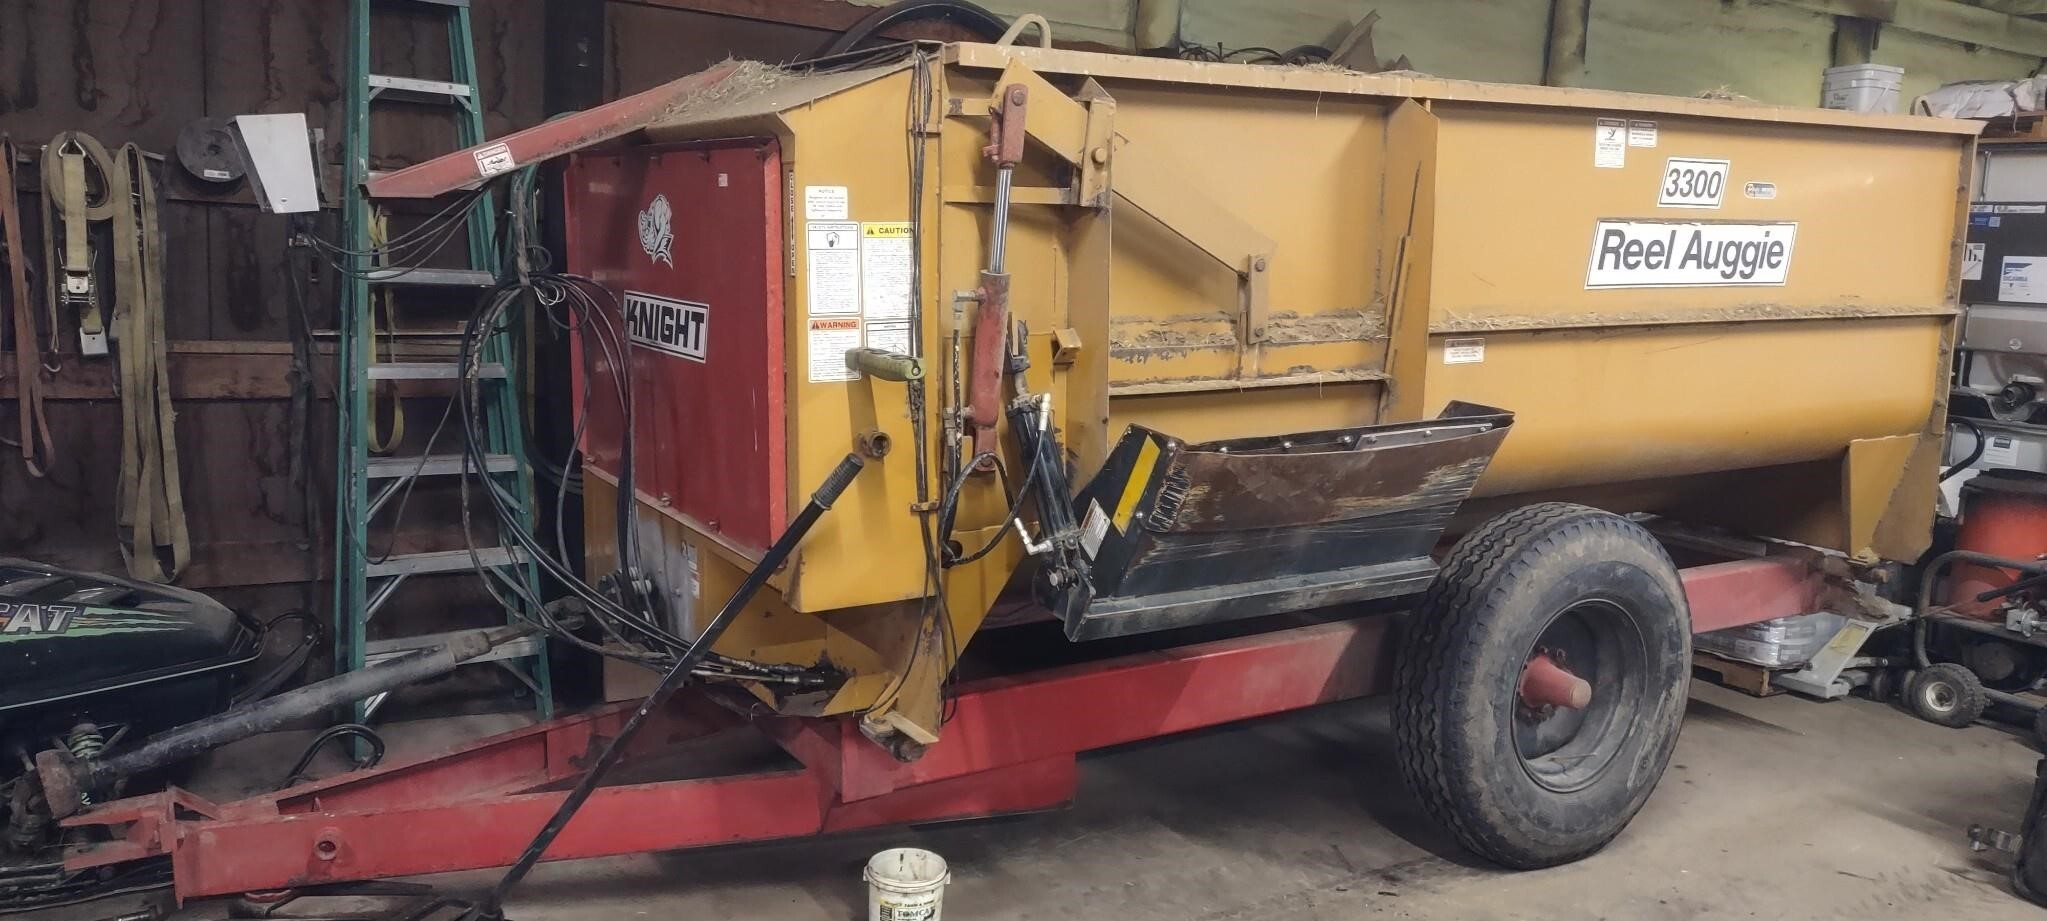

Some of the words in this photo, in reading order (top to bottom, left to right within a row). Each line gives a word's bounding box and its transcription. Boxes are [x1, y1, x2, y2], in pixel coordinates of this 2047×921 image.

[1665, 168, 1722, 199] 3300
[1598, 229, 1677, 270] Reel
[1679, 230, 1784, 280] Auggie
[626, 299, 704, 351] KNIGHT
[820, 321, 857, 329] WARNING
[0, 603, 76, 632] AT
[897, 907, 935, 918] TOMCA
